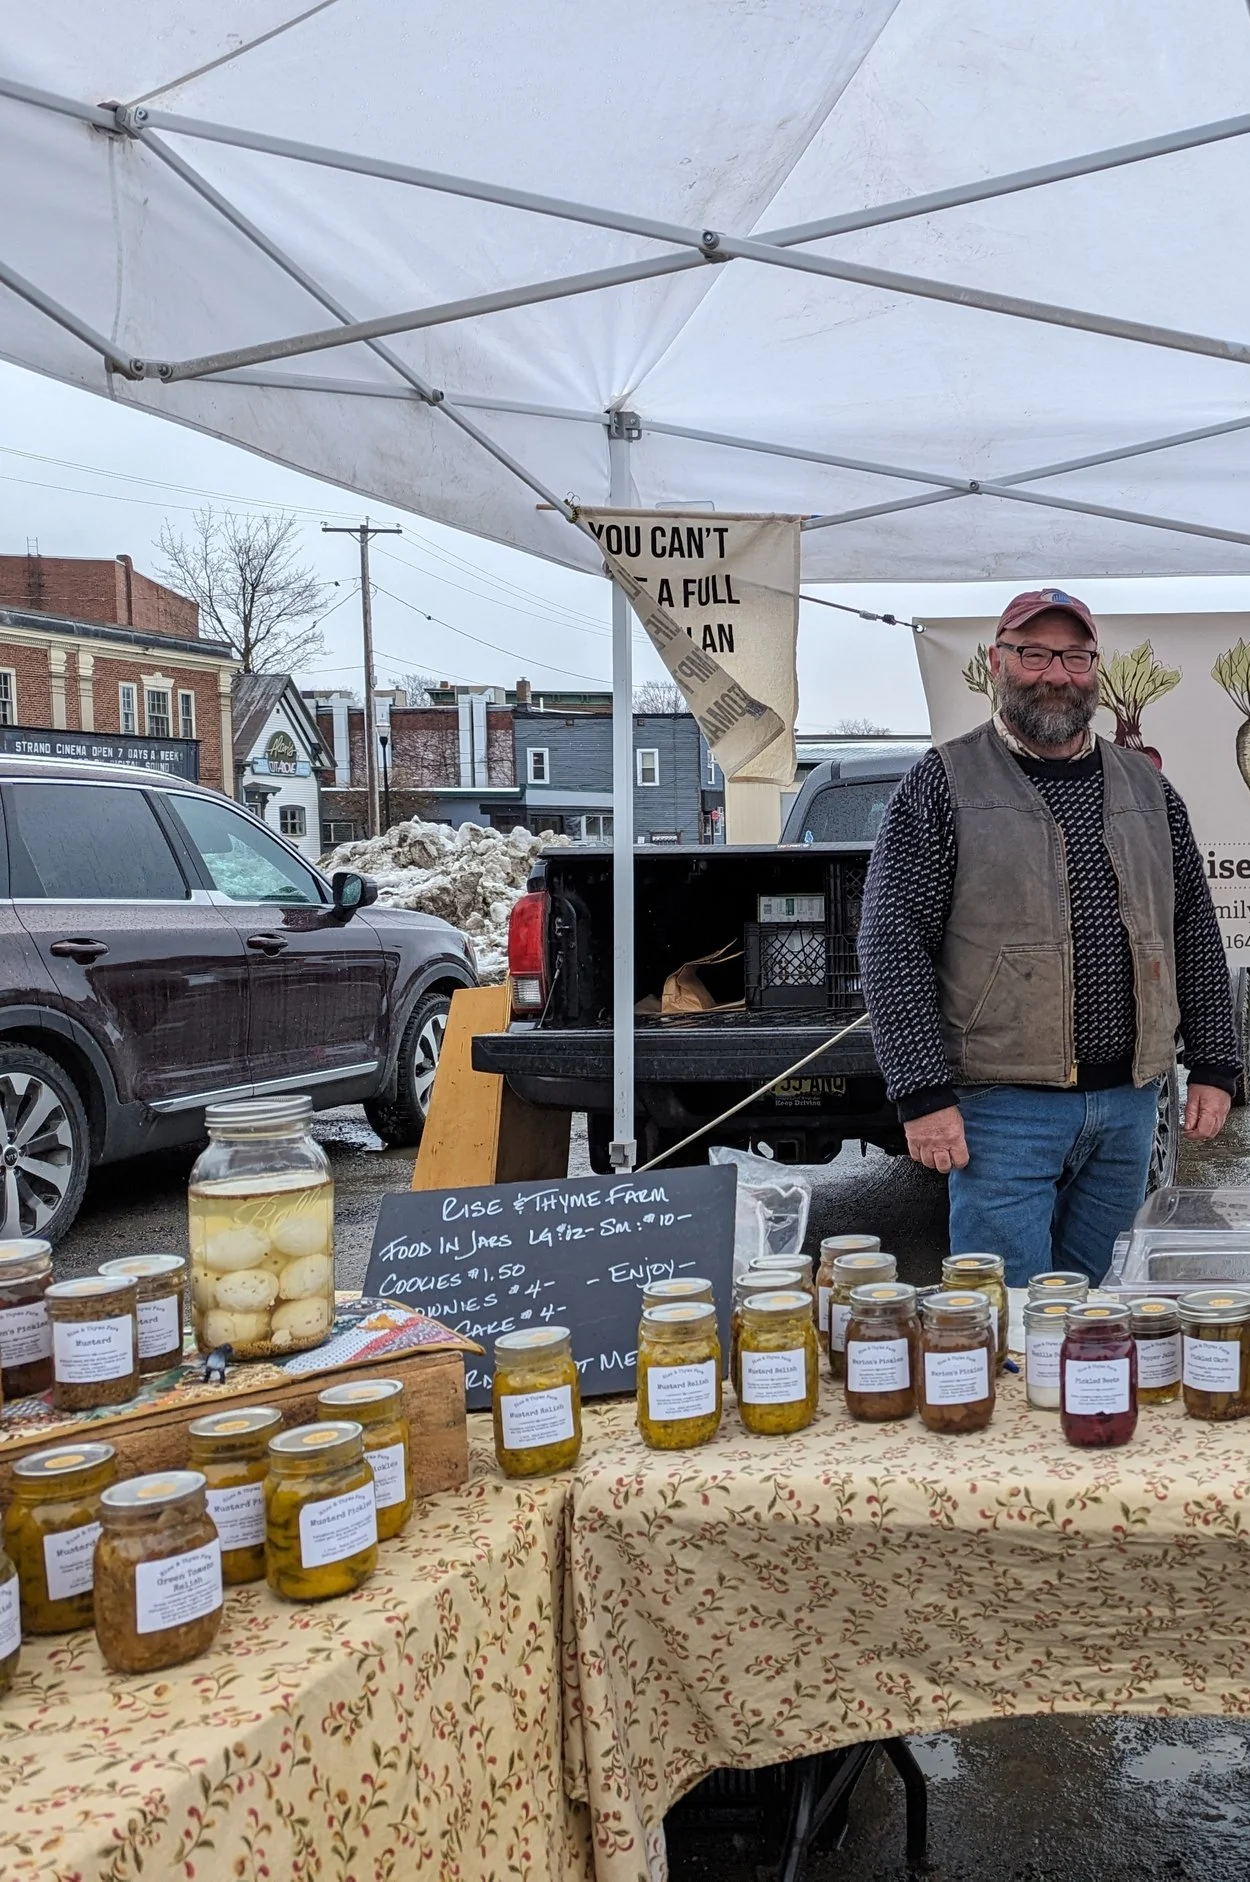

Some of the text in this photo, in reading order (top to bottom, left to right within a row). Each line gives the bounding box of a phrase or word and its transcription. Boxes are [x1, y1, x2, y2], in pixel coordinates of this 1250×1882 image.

[588, 521, 729, 558] YOU CAN'T
[657, 578, 675, 608] A
[682, 573, 741, 608] FULL
[702, 623, 736, 653] AN
[15, 741, 51, 754] STRAND
[56, 743, 87, 756] CINEMA
[92, 747, 113, 758] OPEN
[117, 747, 123, 759] 7
[128, 748, 148, 760] DAYS
[150, 749, 156, 760] A
